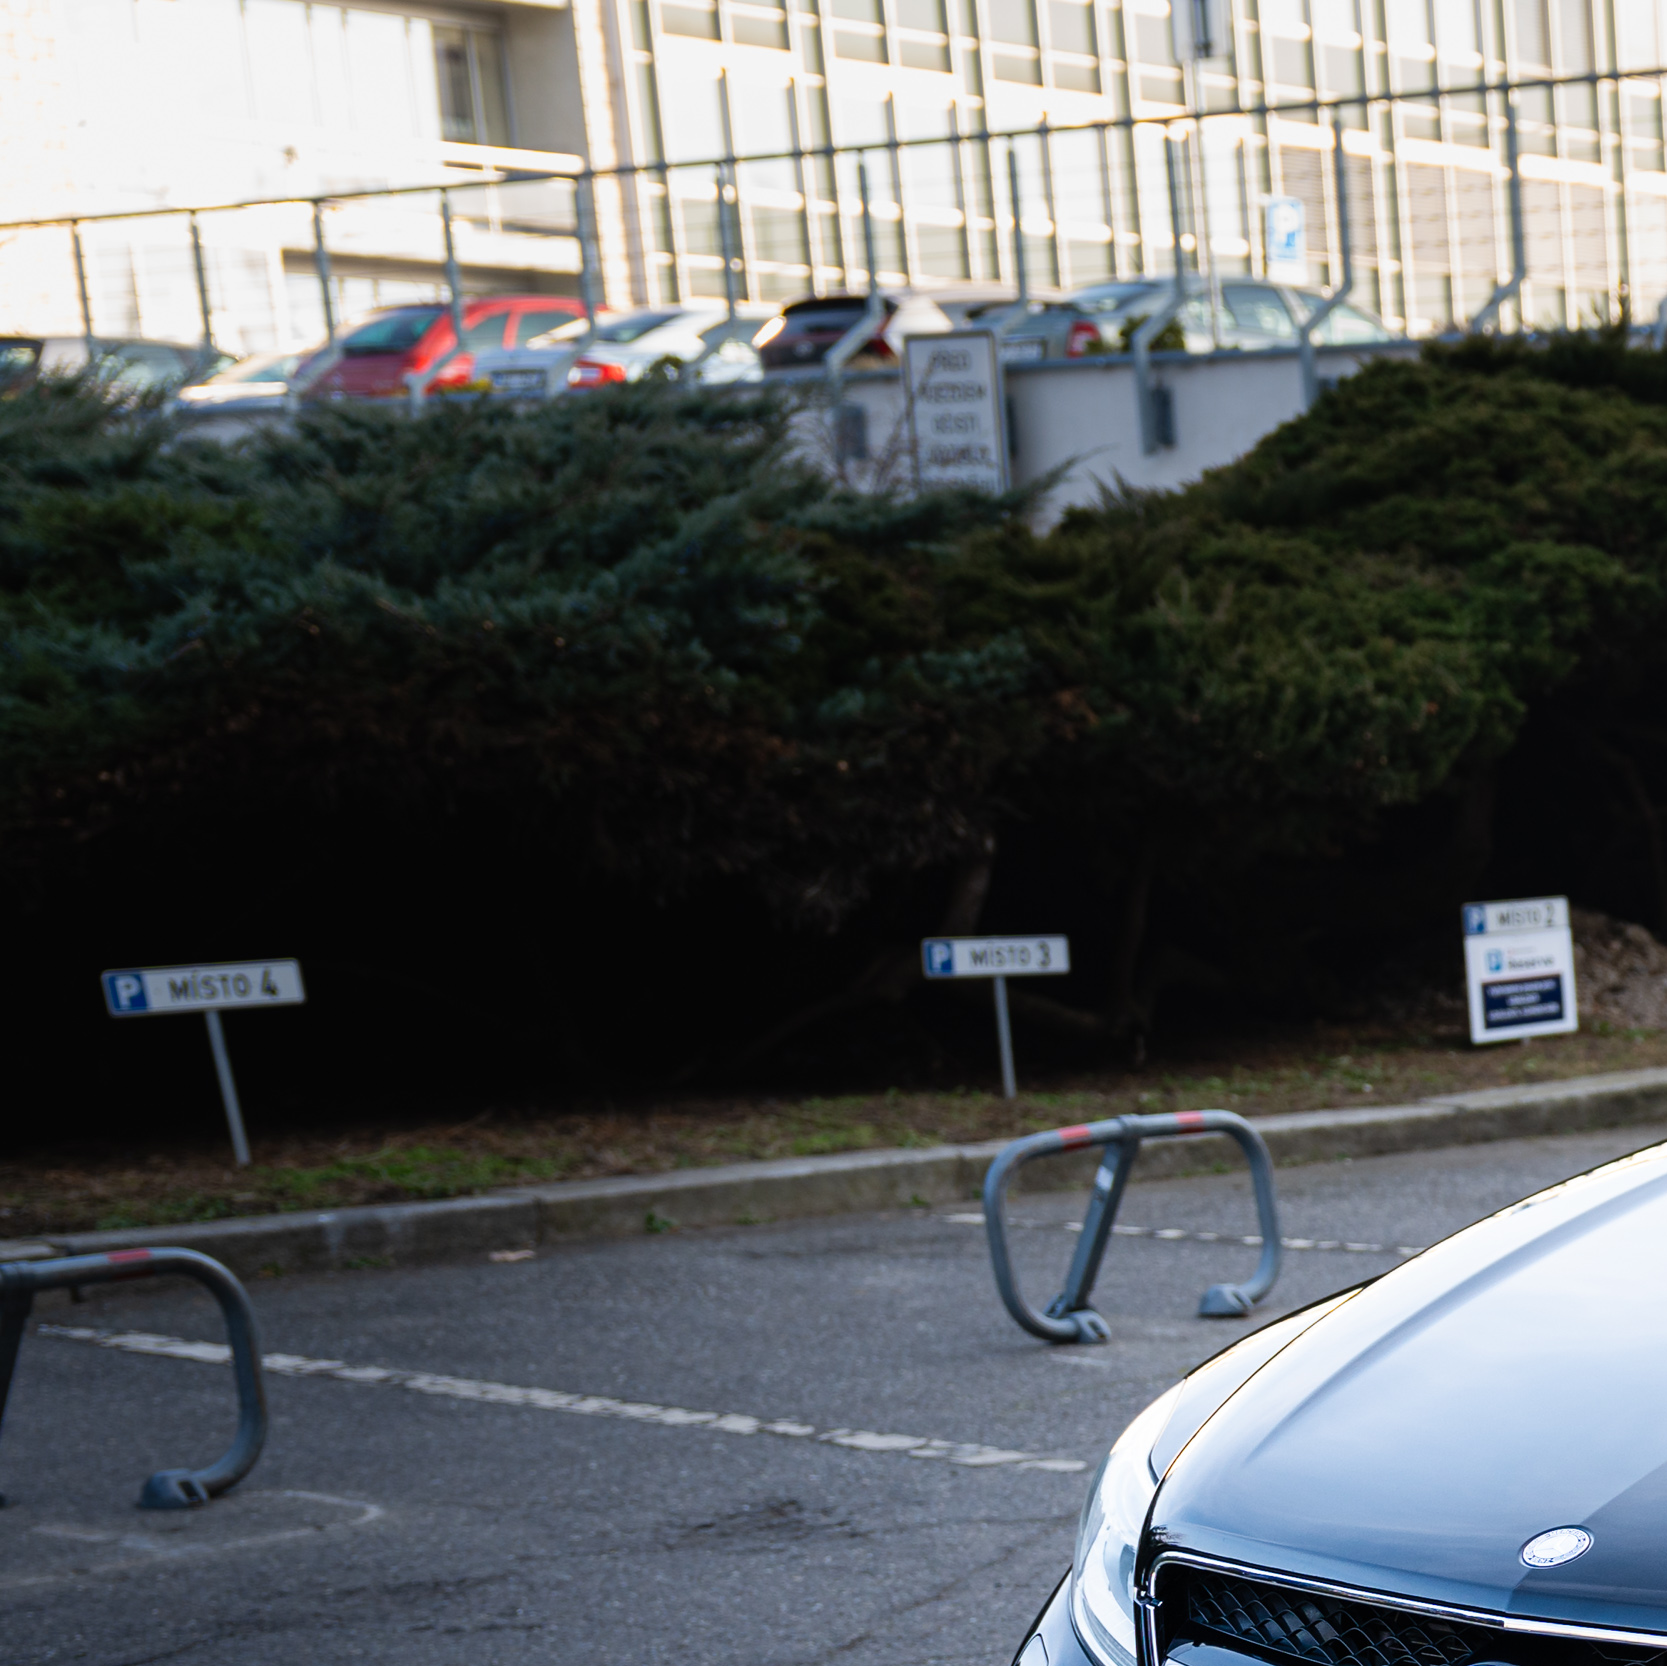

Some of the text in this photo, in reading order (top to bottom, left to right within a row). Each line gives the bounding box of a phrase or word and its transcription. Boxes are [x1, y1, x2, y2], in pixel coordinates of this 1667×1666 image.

[931, 941, 1051, 972] P MÍSTO 3
[115, 968, 278, 1008] P MÍSTO 4
